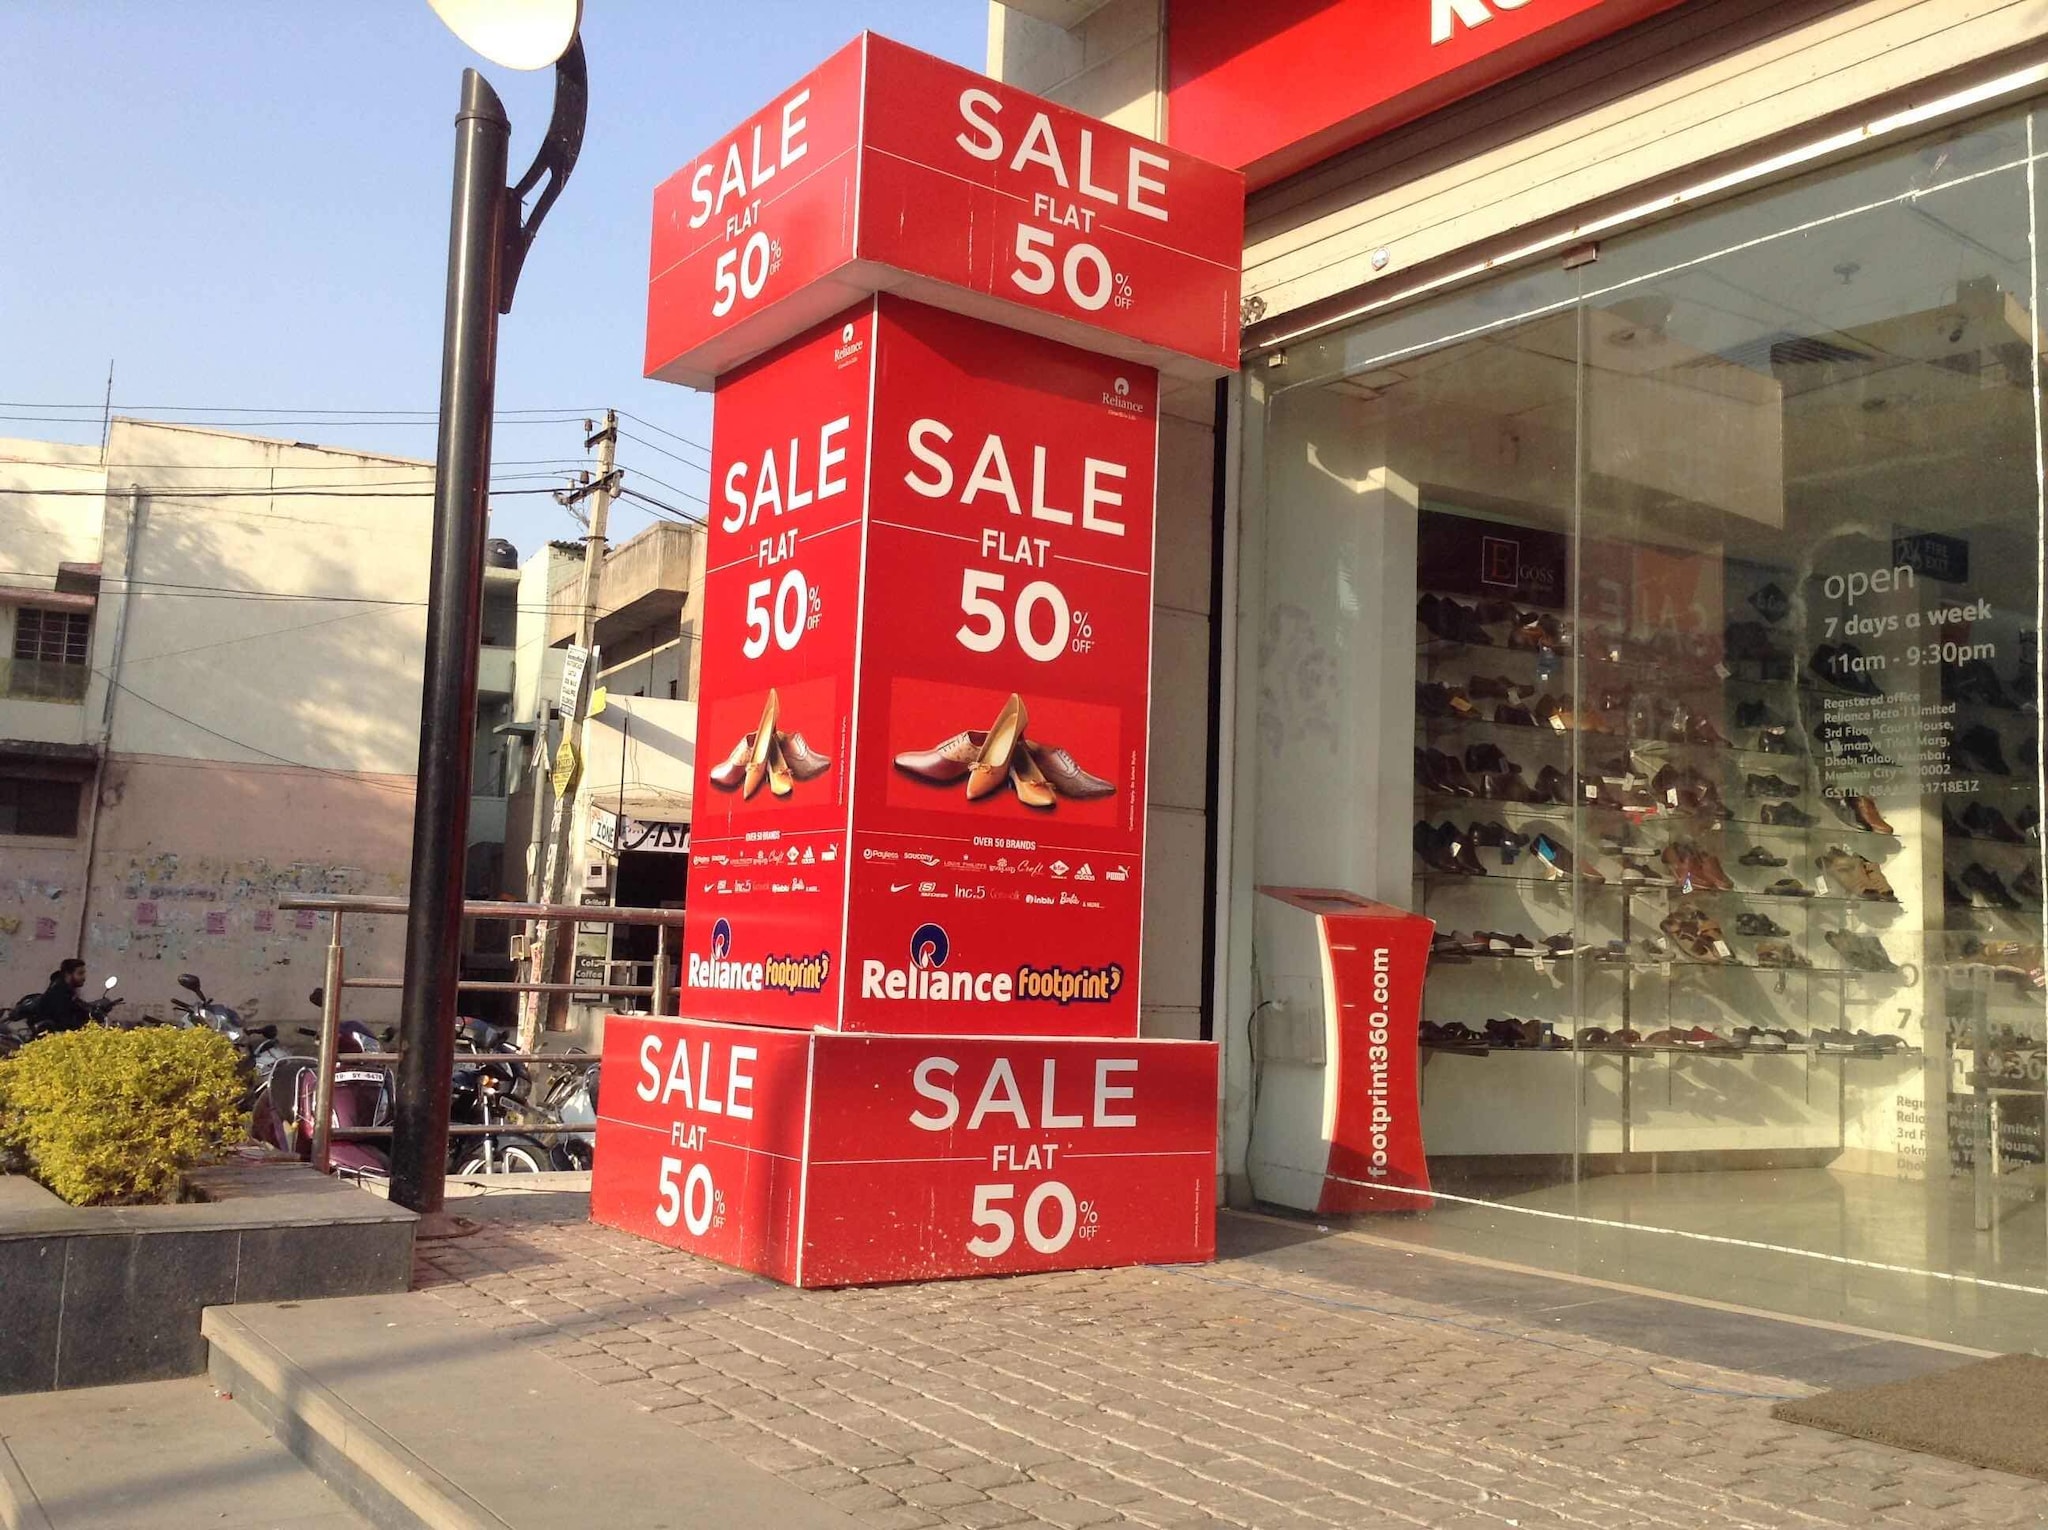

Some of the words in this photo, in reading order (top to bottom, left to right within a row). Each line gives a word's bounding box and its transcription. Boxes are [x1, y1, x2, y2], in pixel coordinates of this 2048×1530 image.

[689, 90, 810, 229] SALE
[955, 87, 1170, 222] SALE
[725, 199, 761, 242] FLAT
[1034, 194, 1095, 233] FLAT
[833, 338, 864, 363] Reliance
[1101, 391, 1144, 413] Reliance
[722, 416, 850, 533] SALE
[903, 418, 1127, 537] SALE
[758, 528, 798, 568] FLAT
[981, 528, 1051, 568] FLAT
[1824, 564, 1914, 605] open
[1824, 618, 1838, 638] 7
[1844, 614, 1898, 638] days
[1905, 614, 1921, 629] a
[1927, 598, 1992, 626] week
[1828, 652, 1885, 674] 11am
[1906, 642, 1995, 666] 9:30pm
[1824, 694, 1883, 710] Registered
[1824, 711, 1871, 724] Reliance
[1824, 727, 1842, 738] 3rd
[1914, 720, 1954, 733] House,
[1917, 735, 1951, 749] Marg,
[1825, 755, 1857, 767] Dhobi
[1861, 753, 1895, 766] Talao,
[1873, 767, 1897, 780] City
[596, 820, 615, 844] ZONE
[973, 836, 993, 848] OVER
[995, 838, 1004, 848] 50
[1006, 839, 1036, 851] BRANDS
[955, 884, 986, 899] Inc.5
[688, 952, 764, 991] Reliance
[765, 955, 821, 992] footprint
[862, 958, 1013, 1003] Reliance
[1018, 966, 1110, 1003] footprint
[1898, 962, 1996, 990] oen
[1897, 1008, 1912, 1029] 7
[636, 1034, 758, 1120] SALE
[1367, 947, 1392, 1178] footprint360.com
[909, 1056, 1139, 1132] SALE
[671, 1121, 707, 1151] FLAT
[1896, 1127, 1916, 1140] 3rd
[992, 1143, 1059, 1172] FLAT
